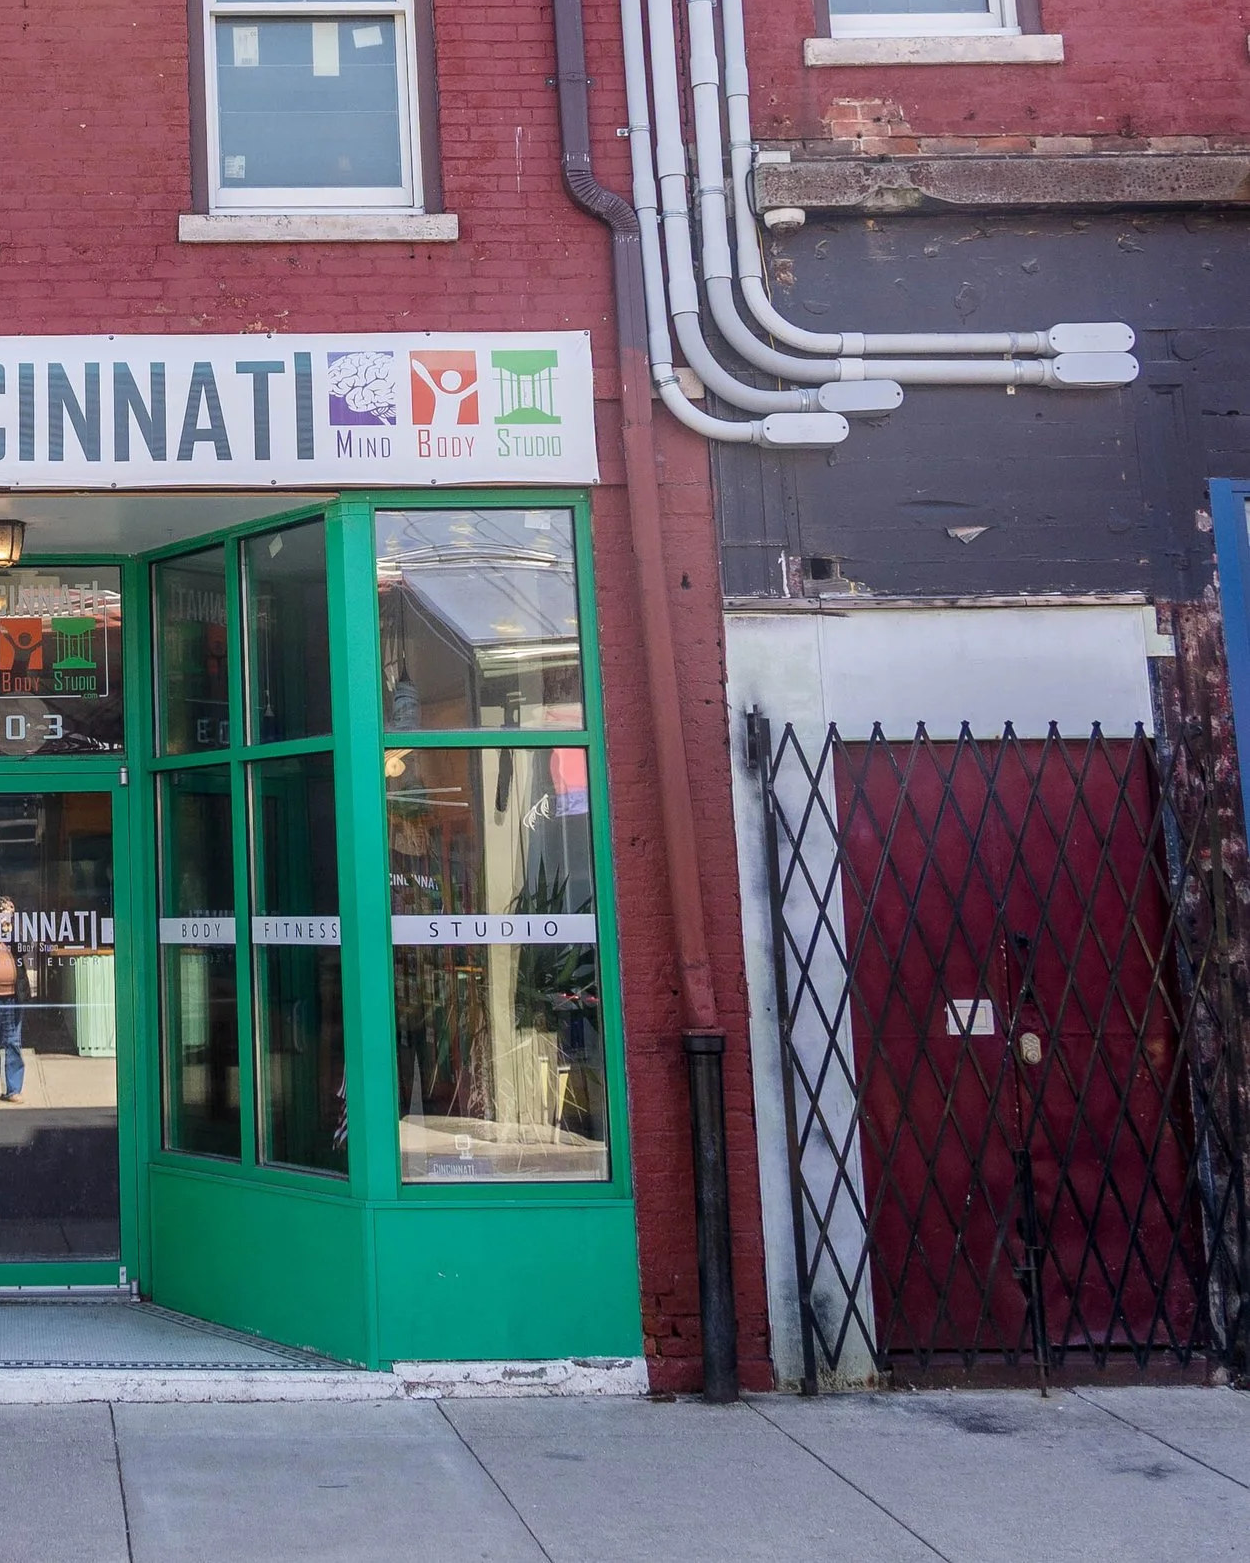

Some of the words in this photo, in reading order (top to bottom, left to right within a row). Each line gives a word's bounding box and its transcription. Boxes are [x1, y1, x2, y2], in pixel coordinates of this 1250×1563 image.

[336, 429, 392, 460] MIND
[418, 429, 475, 459] BODY
[497, 428, 563, 459] STUDIO
[2, 672, 40, 692] BODY
[53, 671, 97, 691] STUDIO
[181, 923, 221, 938] BODY
[264, 922, 338, 939] FITNESS
[429, 920, 558, 938] STUDIO
[47, 957, 100, 968] ELDER
[433, 1163, 475, 1176] CINCINNATI
